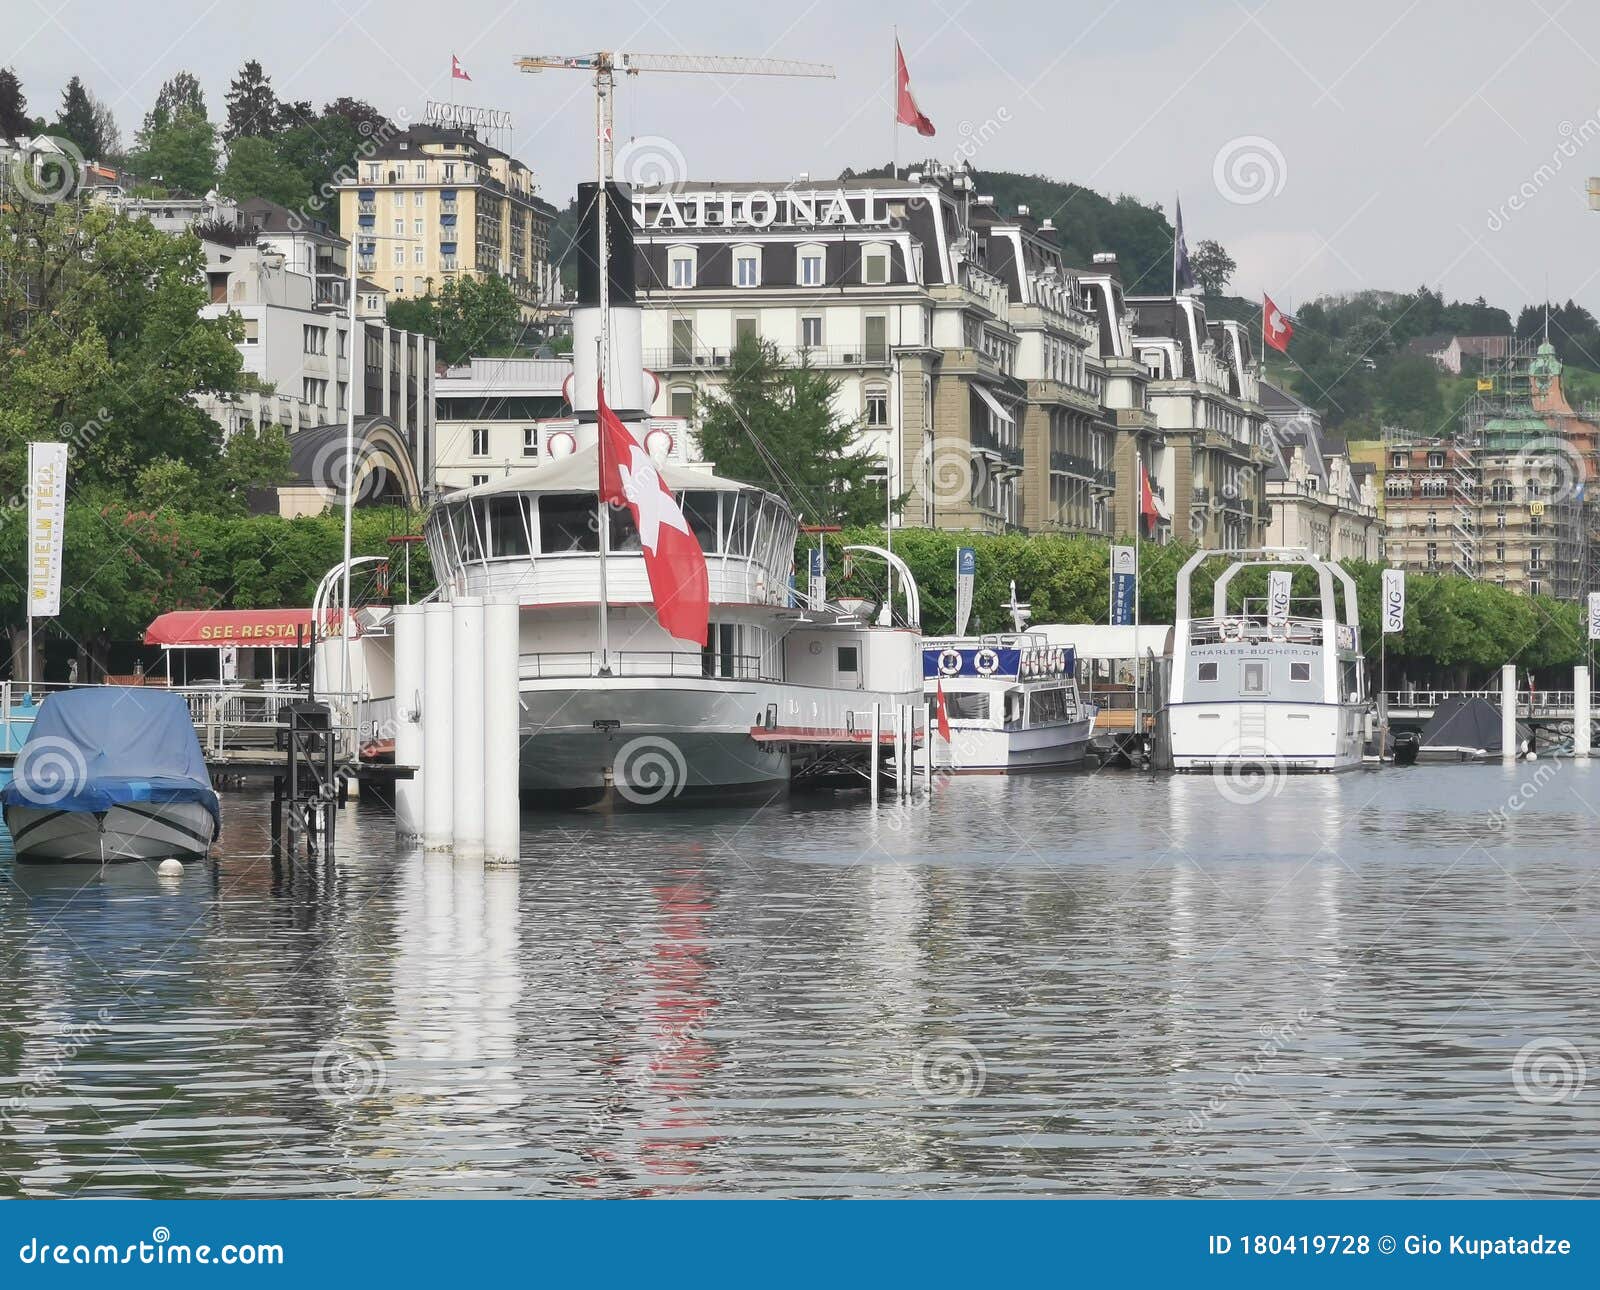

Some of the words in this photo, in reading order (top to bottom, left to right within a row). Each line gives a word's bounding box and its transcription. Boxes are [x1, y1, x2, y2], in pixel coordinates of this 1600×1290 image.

[427, 101, 512, 129] MONTANA
[632, 188, 890, 228] NATIONAL
[36, 463, 54, 511] TELL
[32, 518, 52, 600] WILHELM
[1389, 591, 1402, 630] SNG
